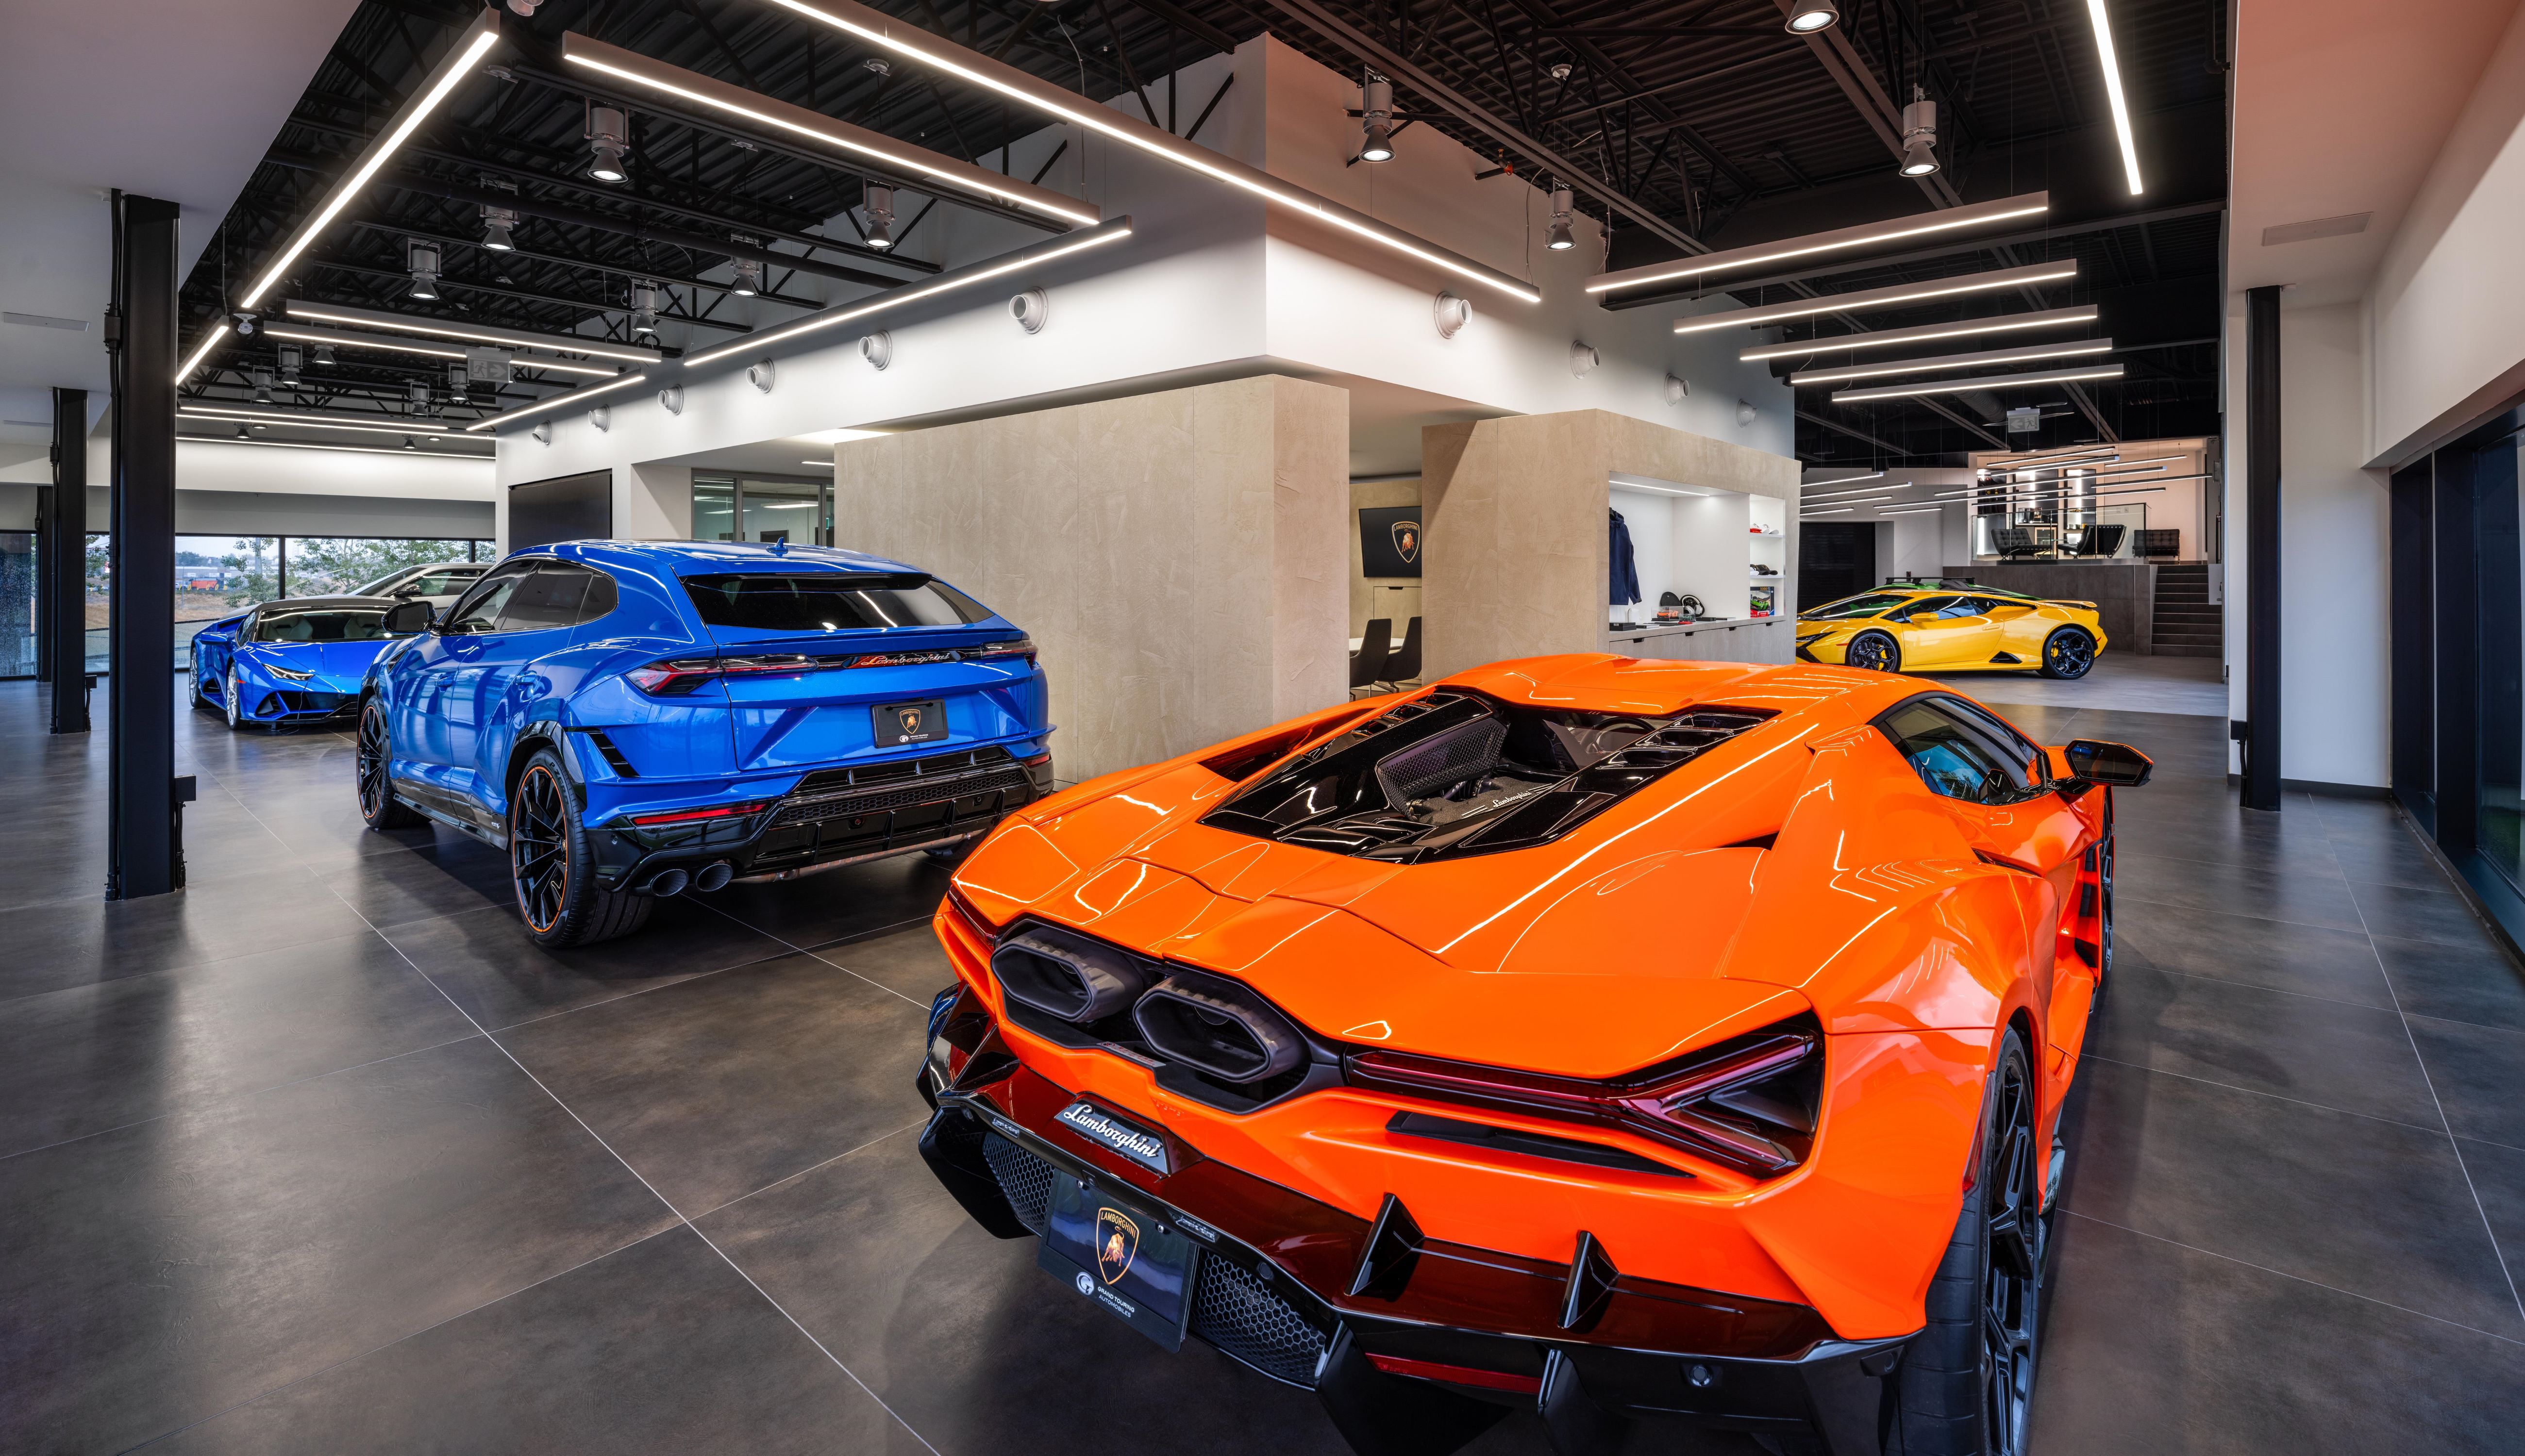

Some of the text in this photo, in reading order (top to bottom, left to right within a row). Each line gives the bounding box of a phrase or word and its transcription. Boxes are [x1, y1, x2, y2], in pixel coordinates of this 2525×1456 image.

[861, 653, 950, 665] Lamborghini
[1492, 791, 1532, 808] Lamborghini
[1063, 1105, 1161, 1157] Lamborghini
[1101, 1212, 1136, 1239] LAMBORGHINI
[1098, 1286, 1135, 1313] GRAND TOURING
[1099, 1294, 1131, 1318] AUTOMOBILES
